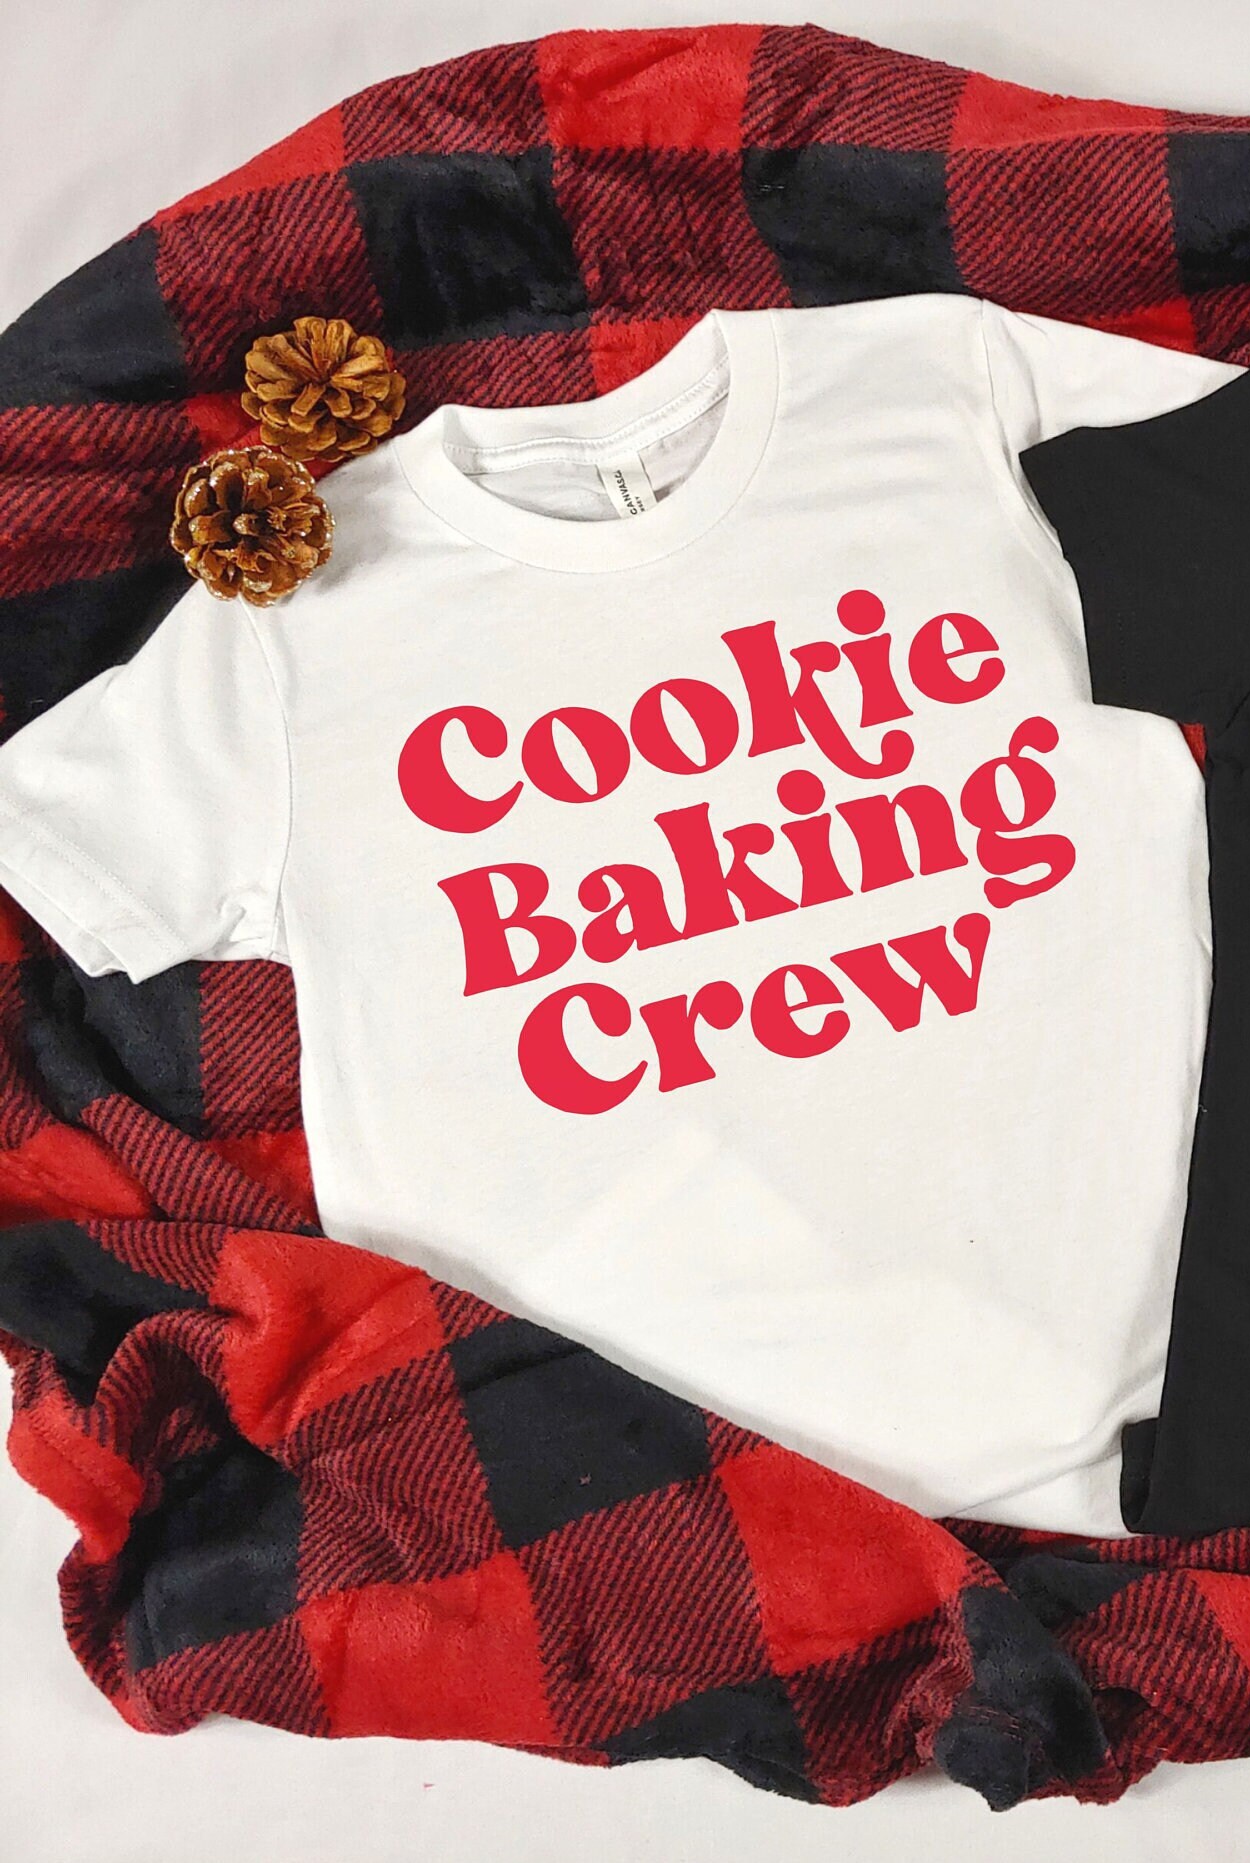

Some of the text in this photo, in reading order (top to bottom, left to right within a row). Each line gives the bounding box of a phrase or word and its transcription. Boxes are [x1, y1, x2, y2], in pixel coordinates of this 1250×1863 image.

[398, 589, 1005, 833] Cookie
[438, 717, 1076, 996] Baking
[518, 913, 991, 1115] Crew
